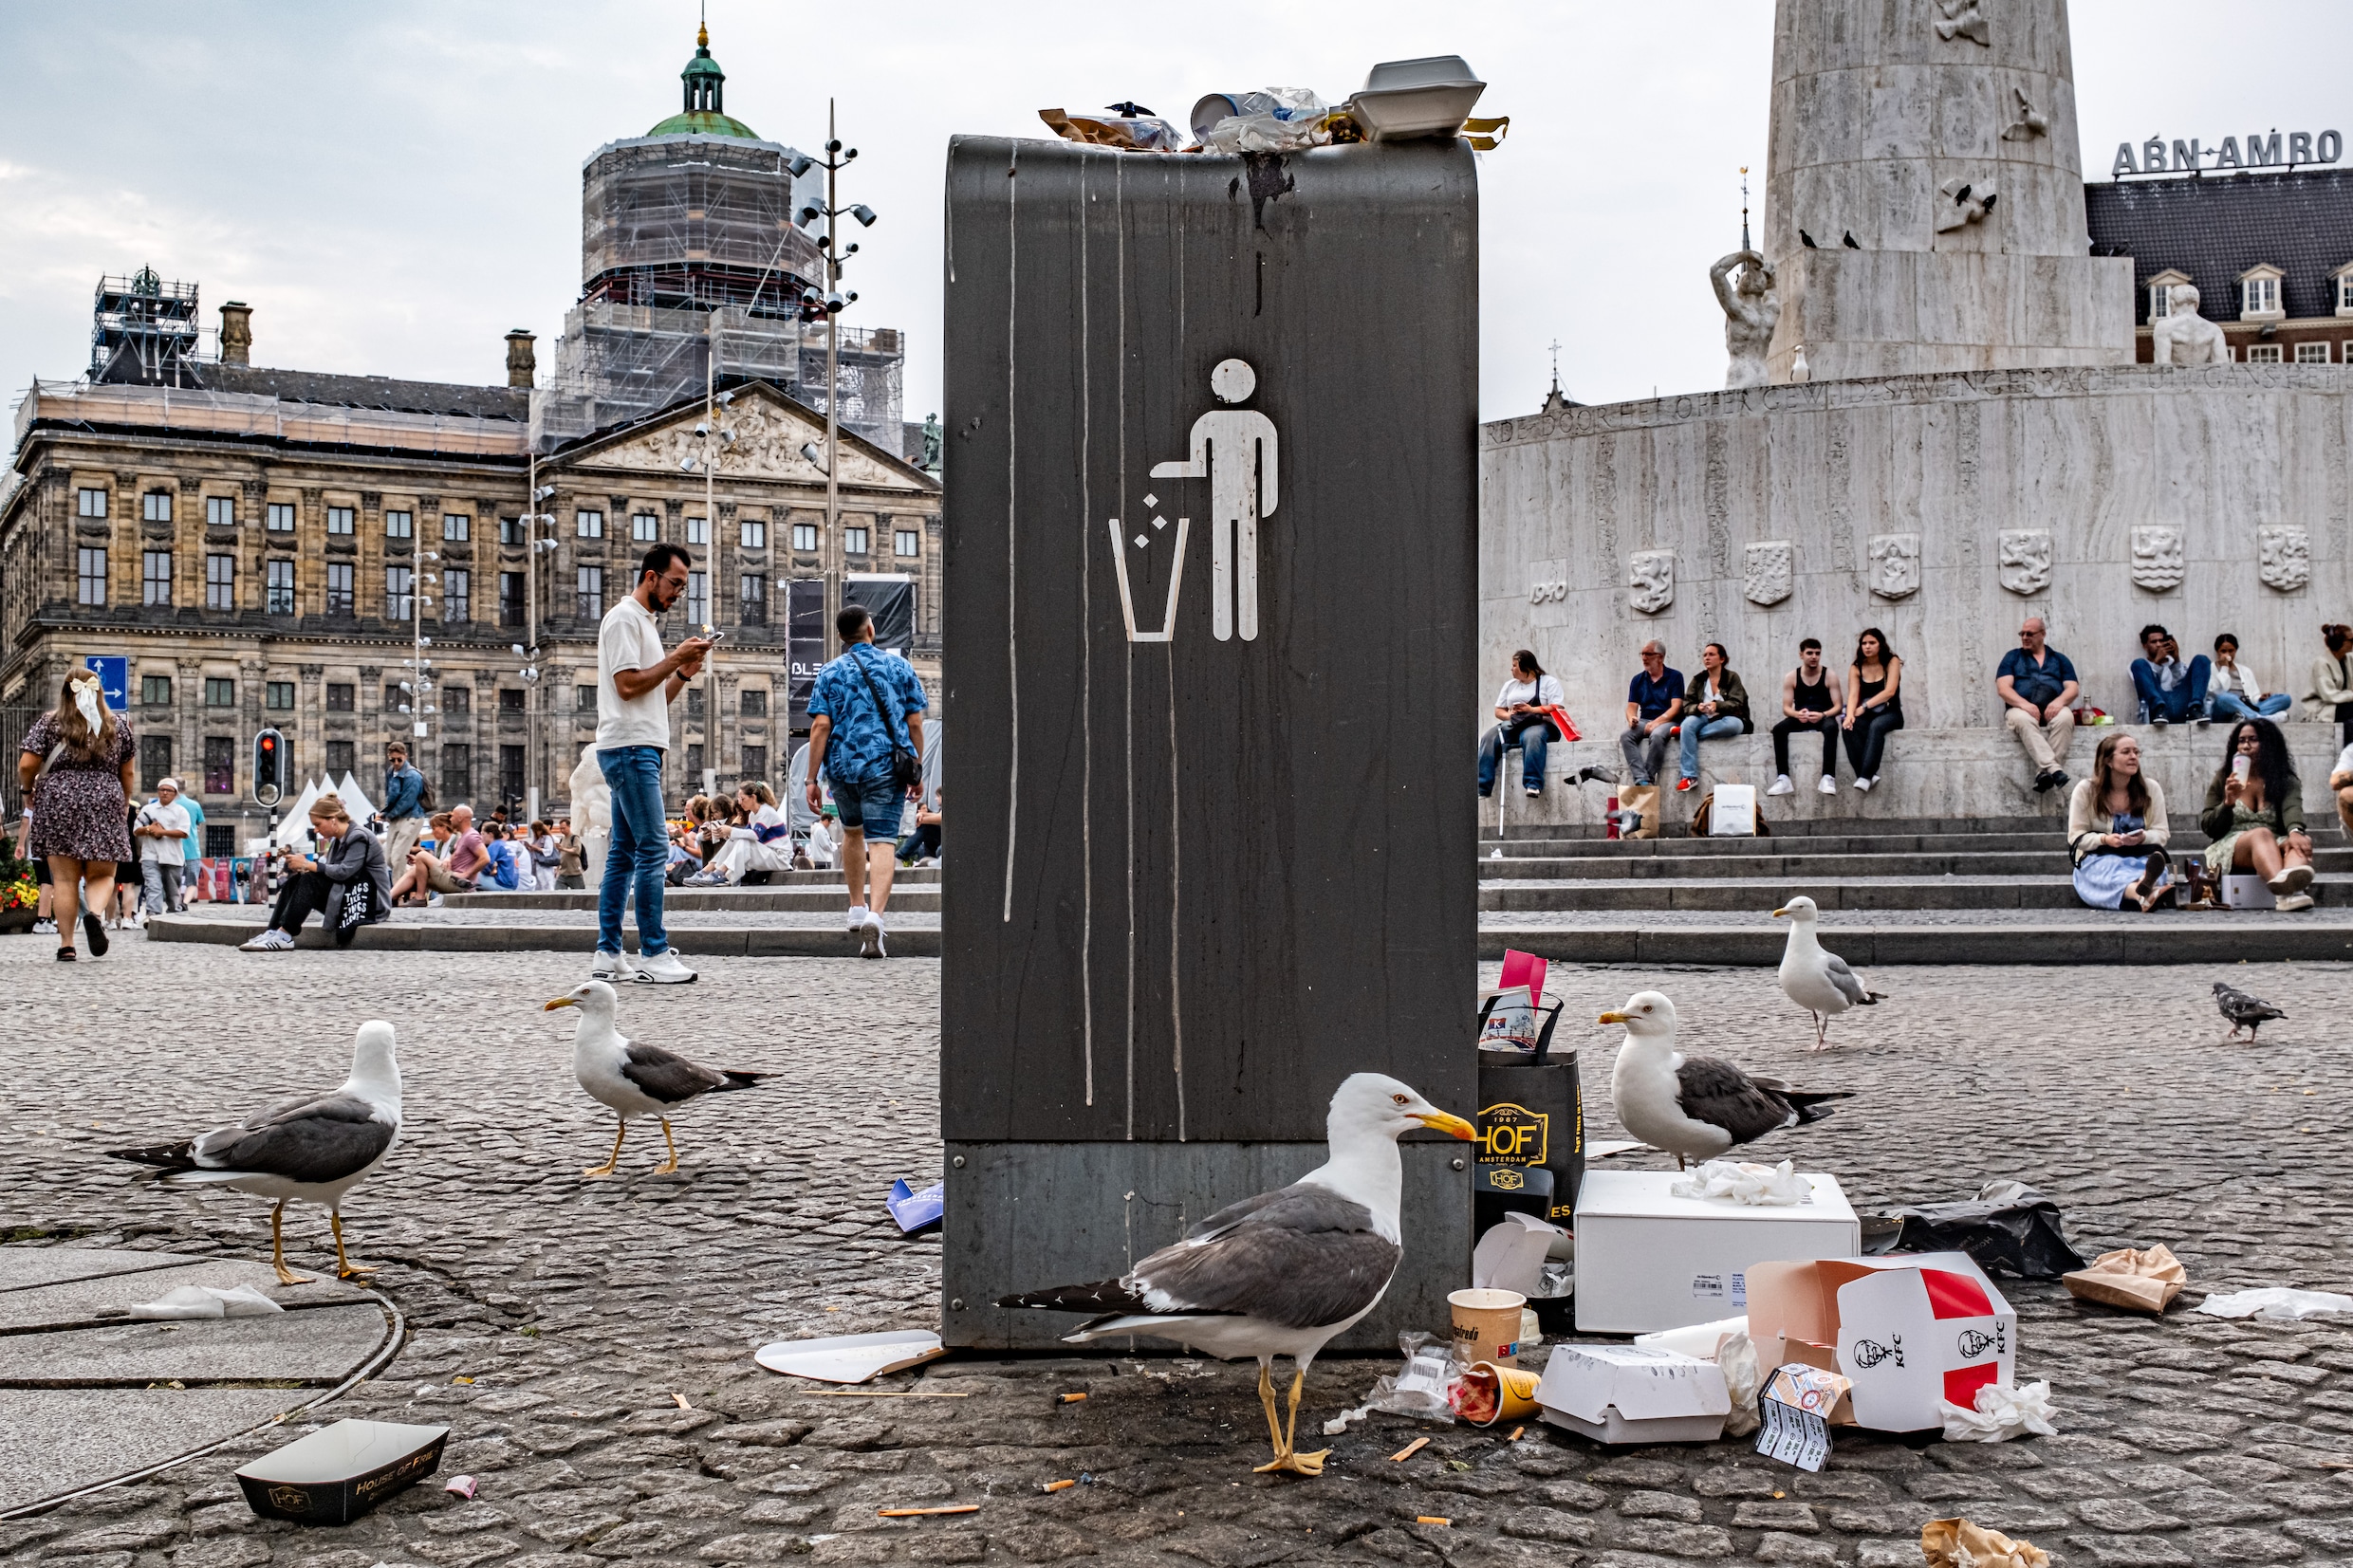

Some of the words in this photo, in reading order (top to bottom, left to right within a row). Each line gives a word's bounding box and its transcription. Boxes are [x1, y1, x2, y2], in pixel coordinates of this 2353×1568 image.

[2112, 138, 2199, 175] ABN
[2216, 129, 2343, 168] AMRO
[1529, 581, 1566, 605] 1940
[1477, 1125, 1537, 1154] HOF
[1494, 1173, 1518, 1184] HOF
[1550, 1205, 1570, 1218] ES
[1892, 1333, 1905, 1368] KFC
[1996, 1320, 2006, 1355] KFC
[356, 1469, 397, 1496] HOUSE
[397, 1462, 413, 1476] OF
